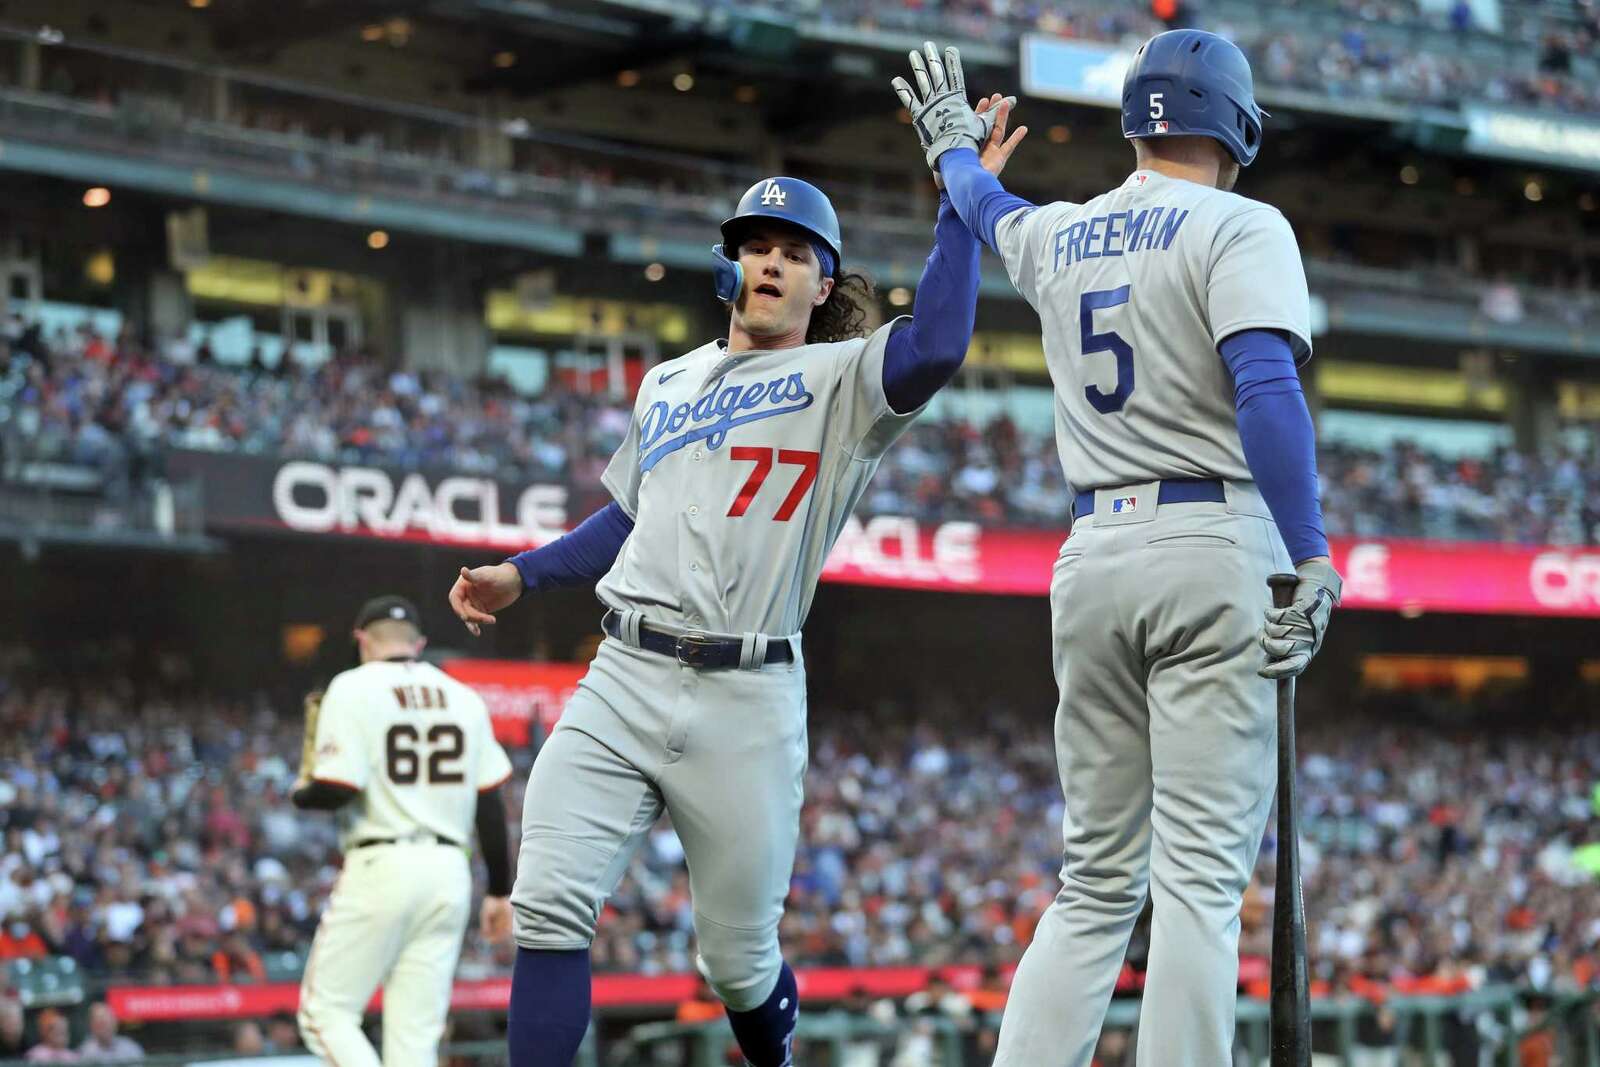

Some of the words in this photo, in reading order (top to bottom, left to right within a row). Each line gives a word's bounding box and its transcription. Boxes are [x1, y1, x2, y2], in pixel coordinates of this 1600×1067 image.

[1150, 93, 1163, 119] 5
[761, 179, 786, 206] LA
[1054, 207, 1189, 272] FREEMAN
[1080, 284, 1135, 414] 5
[639, 372, 811, 455] Dodgers
[272, 461, 568, 548] ORACLE
[726, 446, 820, 522] 77
[386, 724, 465, 785] 62
